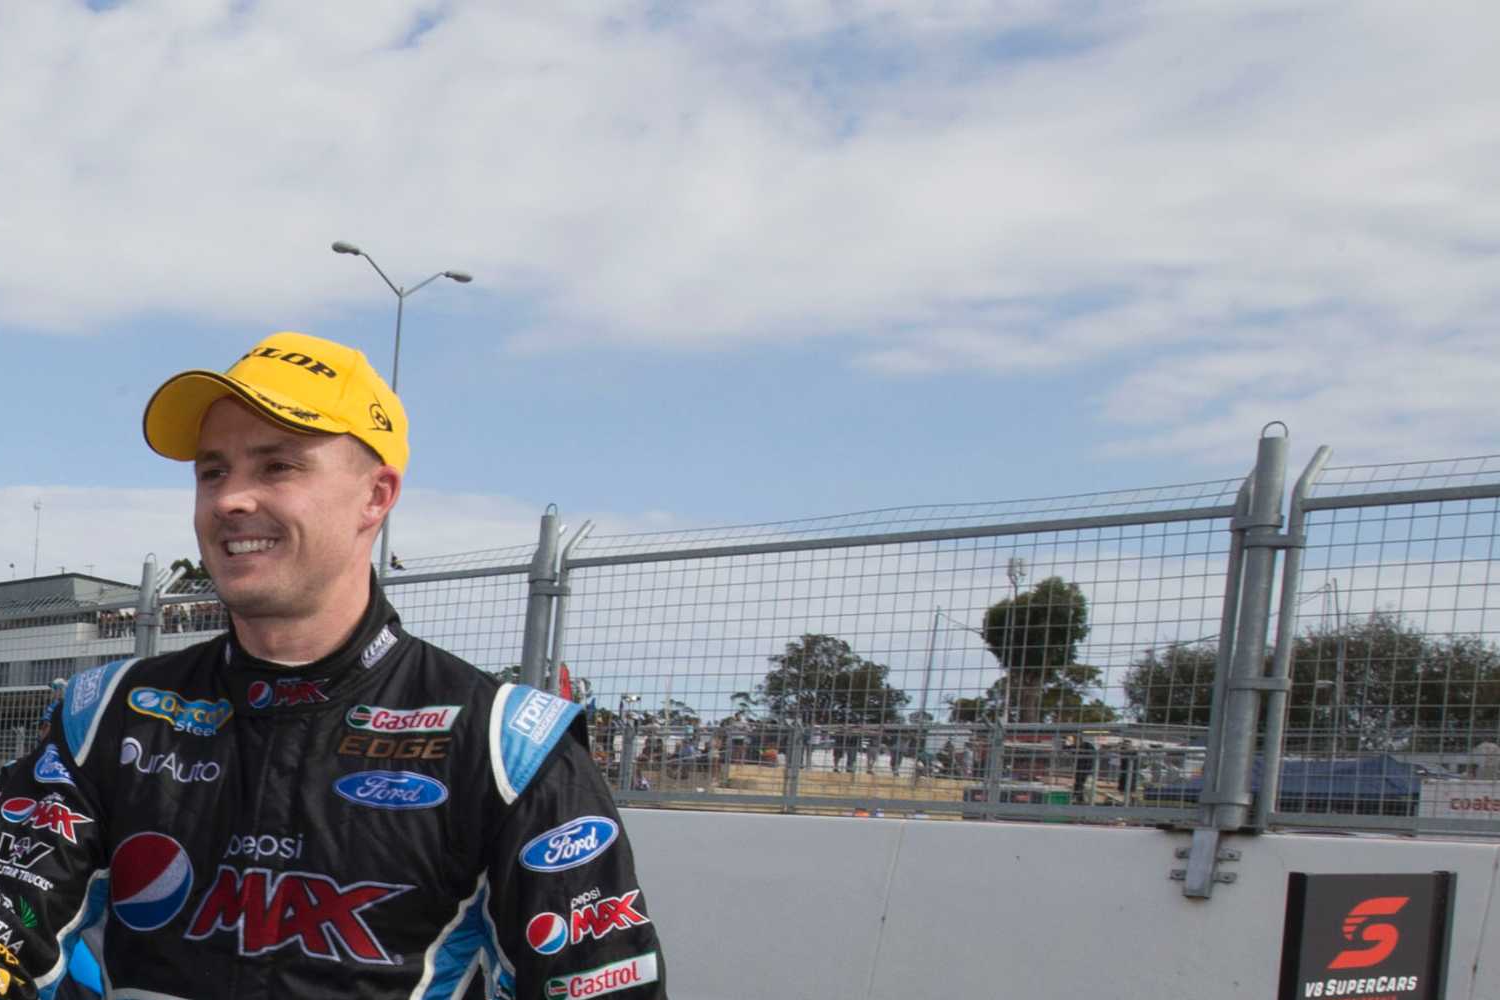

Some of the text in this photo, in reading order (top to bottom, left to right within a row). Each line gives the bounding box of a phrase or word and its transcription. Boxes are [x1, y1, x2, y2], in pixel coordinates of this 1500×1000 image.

[242, 347, 337, 379] LOP
[371, 709, 448, 730] Castrol
[338, 735, 453, 760] EDGE
[356, 776, 425, 803] Ford
[223, 833, 304, 861] pepsi
[544, 826, 599, 863] Ford
[570, 887, 602, 908] pepsi
[184, 864, 417, 966] MAX
[570, 889, 650, 945] MAX
[570, 961, 641, 998] Castrol
[1304, 981, 1324, 998] V8
